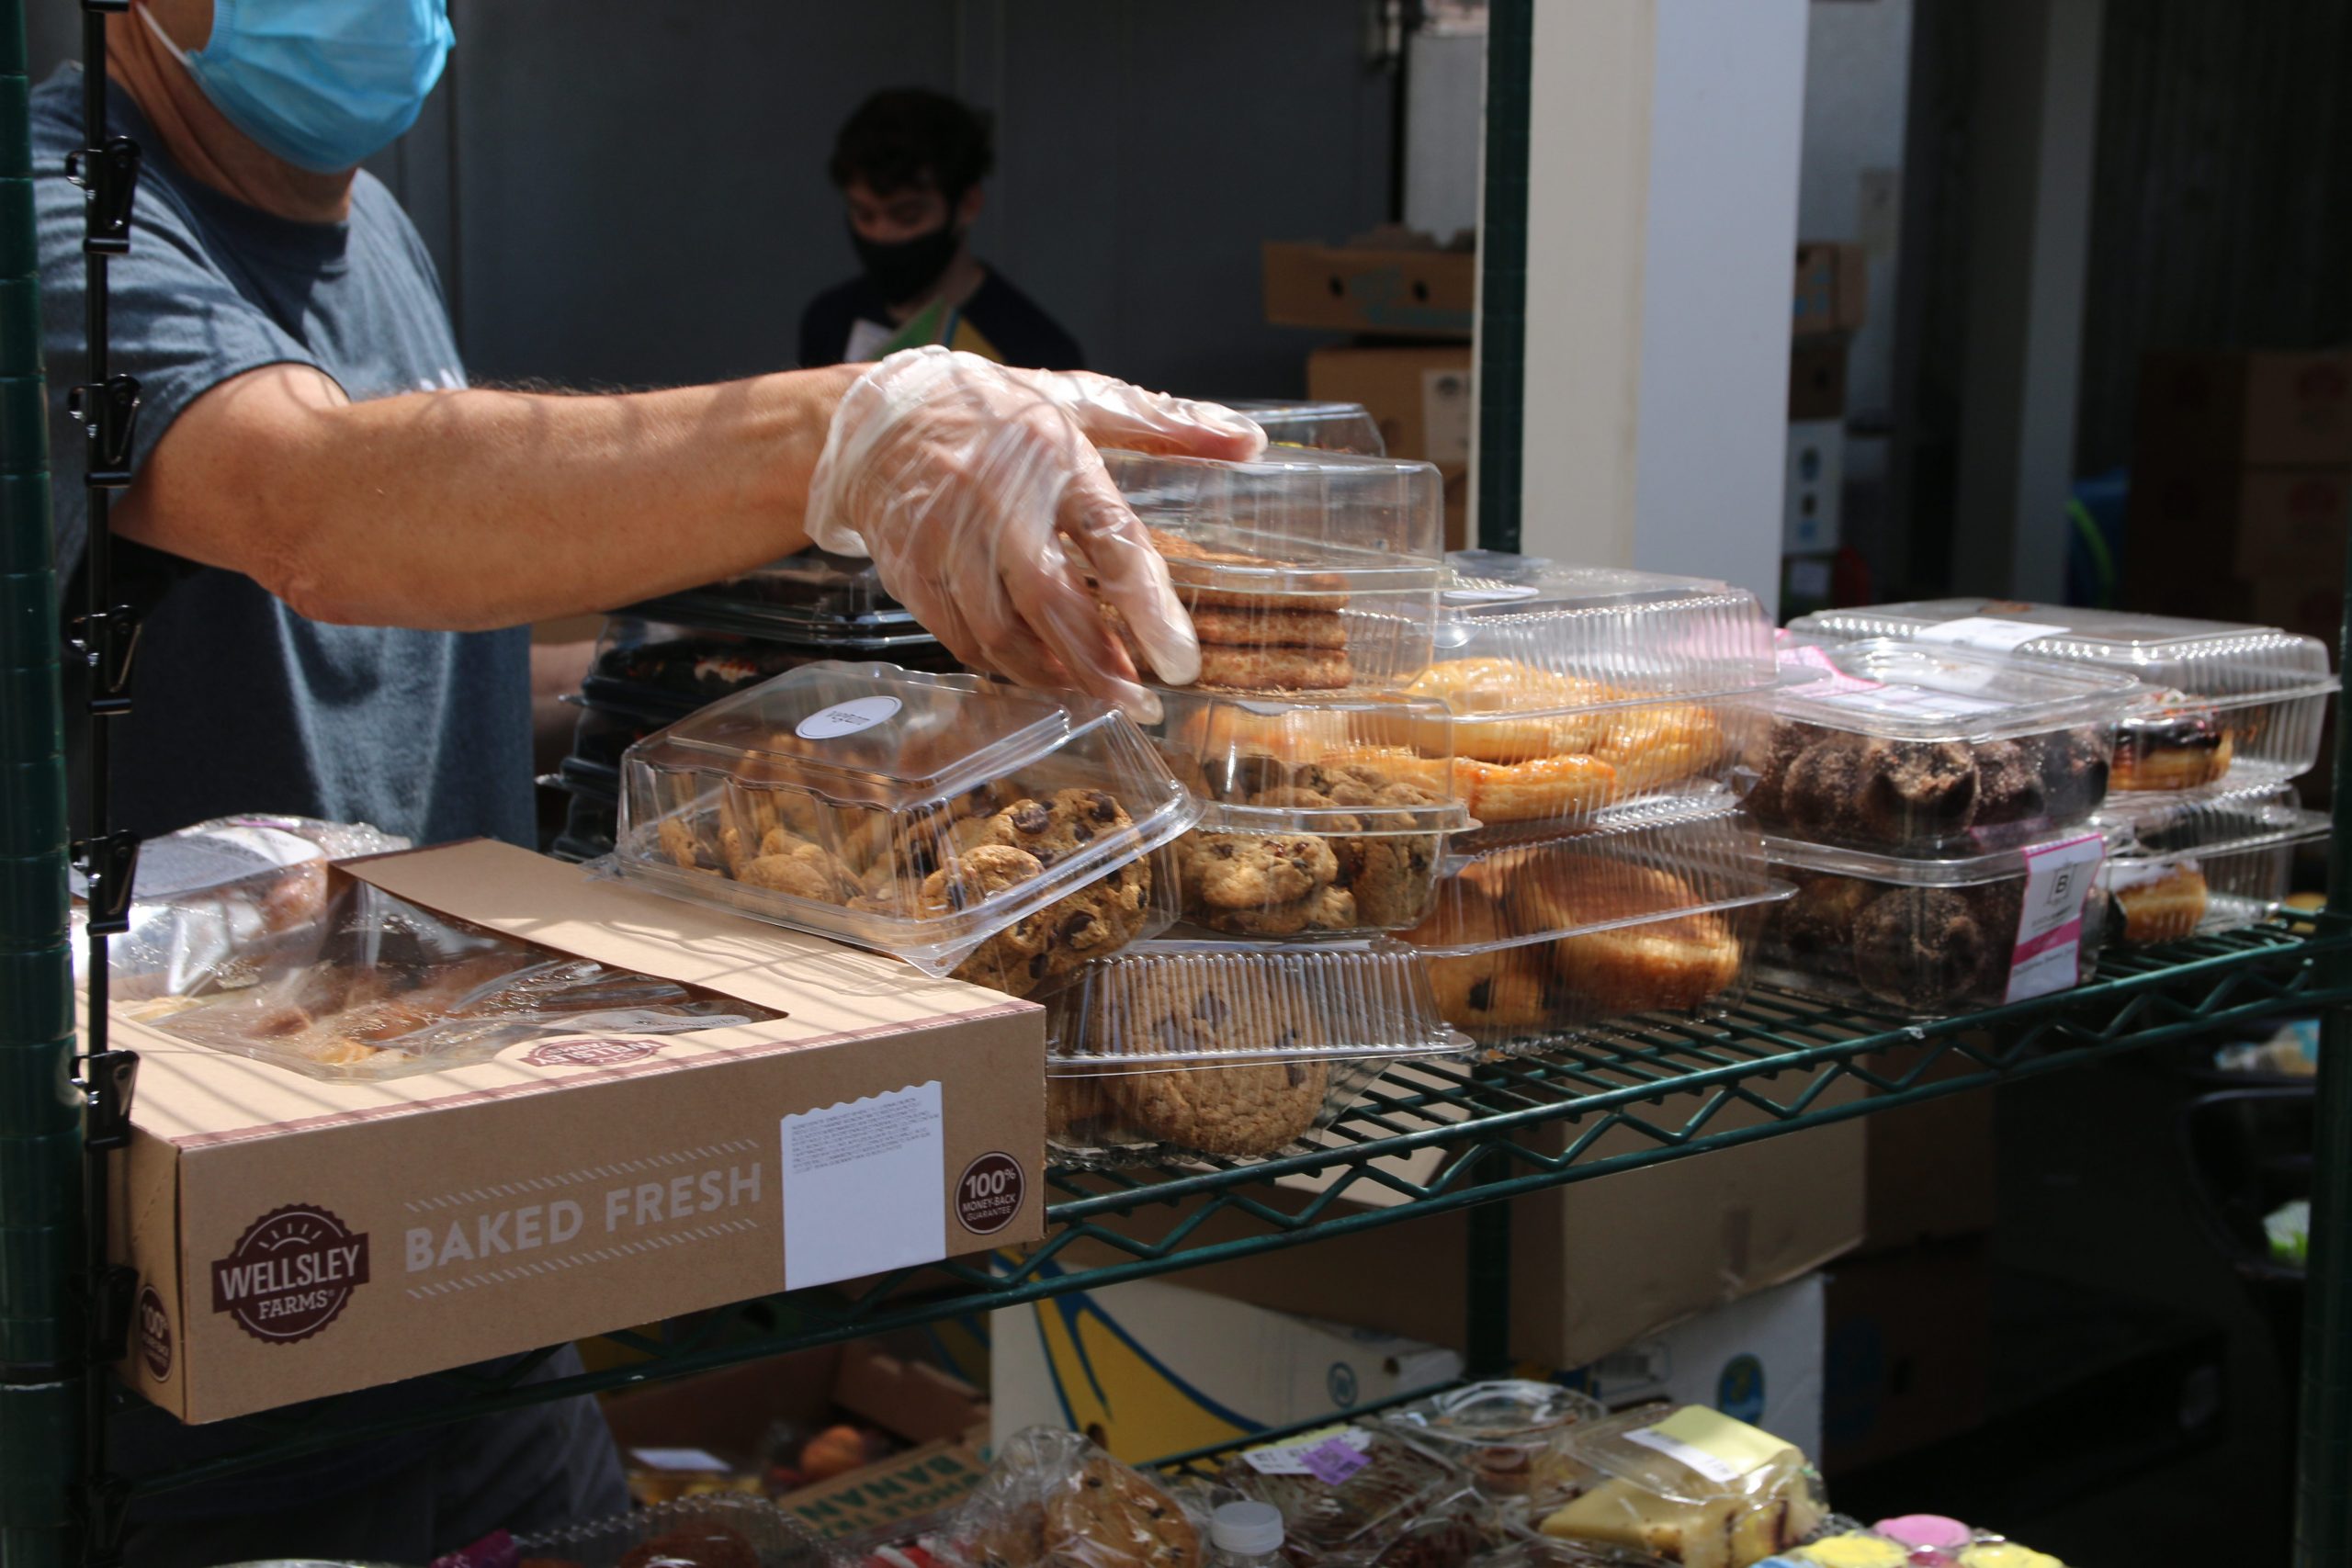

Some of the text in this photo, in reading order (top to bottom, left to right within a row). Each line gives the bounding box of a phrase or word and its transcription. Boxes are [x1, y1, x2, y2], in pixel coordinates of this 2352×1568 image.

[2055, 875, 2069, 893] B
[533, 1042, 662, 1066] WELLSLEY
[966, 1168, 1017, 1199] 100%
[962, 1193, 1016, 1213] MONEY-BACK
[967, 1205, 1012, 1222] GUARANTEE
[405, 1162, 762, 1273] BAKED FRESH
[220, 1244, 360, 1301] WELLSLEY
